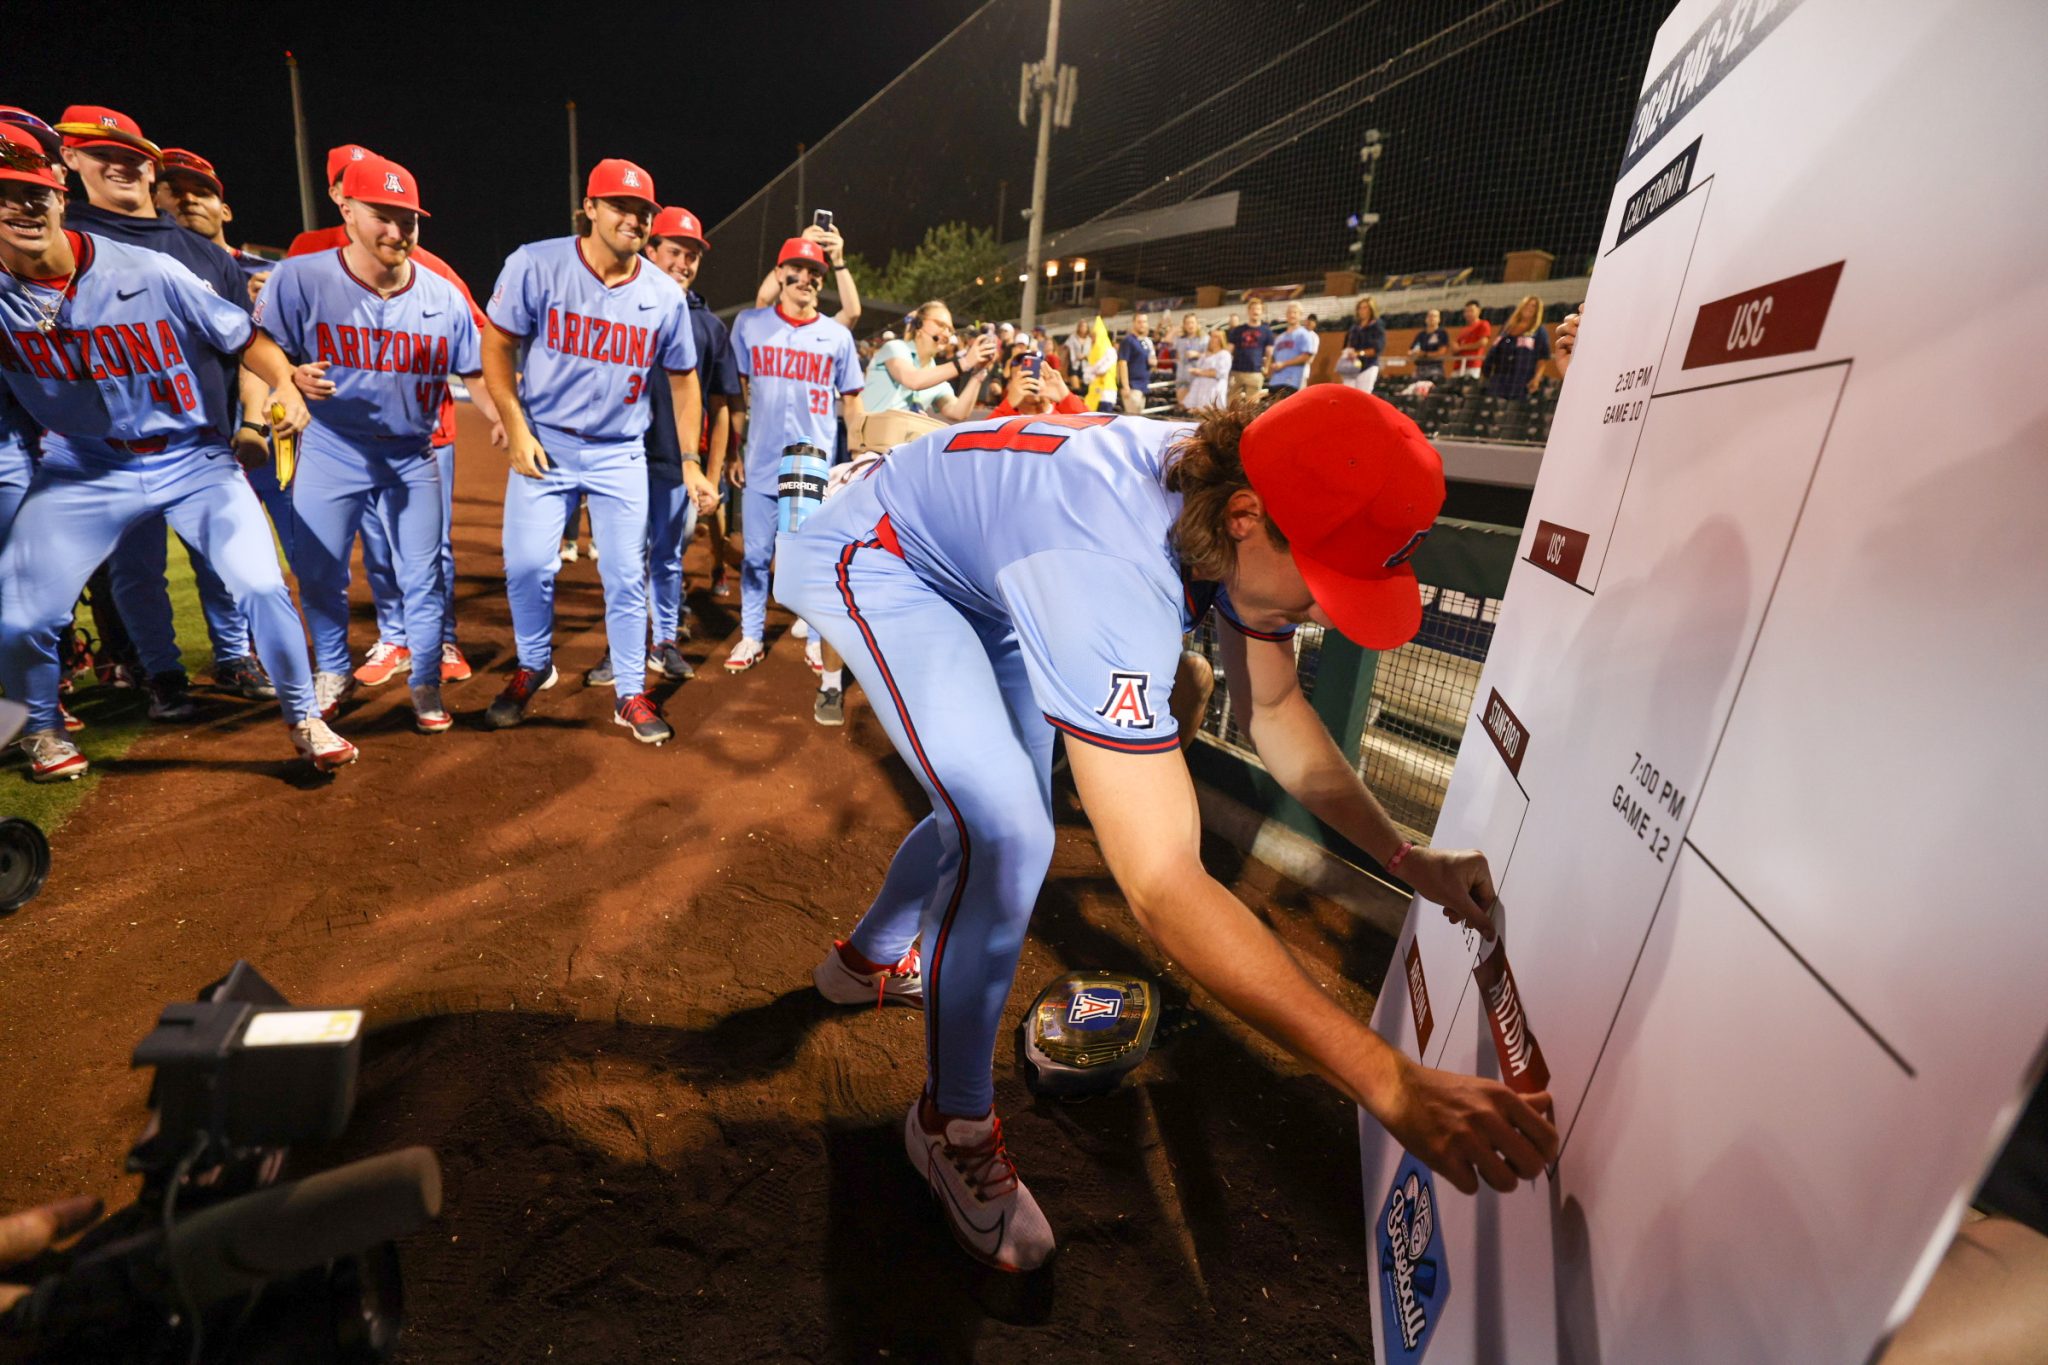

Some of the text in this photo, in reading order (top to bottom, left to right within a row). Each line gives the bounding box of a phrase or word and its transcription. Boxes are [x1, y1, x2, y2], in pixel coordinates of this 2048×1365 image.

[1628, 79, 1669, 158] 2024
[1624, 155, 1689, 233] CALIFORNIA
[316, 322, 449, 376] ARIZONA
[1726, 296, 1774, 351] USC
[148, 372, 197, 415] 48
[752, 346, 834, 387] ARIZONA
[1614, 365, 1654, 394] 2:30 PM
[809, 388, 829, 416] 33
[1603, 400, 1644, 424] GAME 10
[1546, 532, 1565, 565] USC
[1094, 671, 1157, 730] A
[1488, 699, 1521, 760] STANFORD
[1630, 751, 1686, 822] 7:00 PM
[1612, 784, 1671, 863] GAME 12
[1068, 993, 1121, 1024] A
[1409, 957, 1428, 1031] ARIZONA
[1489, 970, 1533, 1077] ARIZONA
[1387, 1188, 1426, 1348] Baseball
